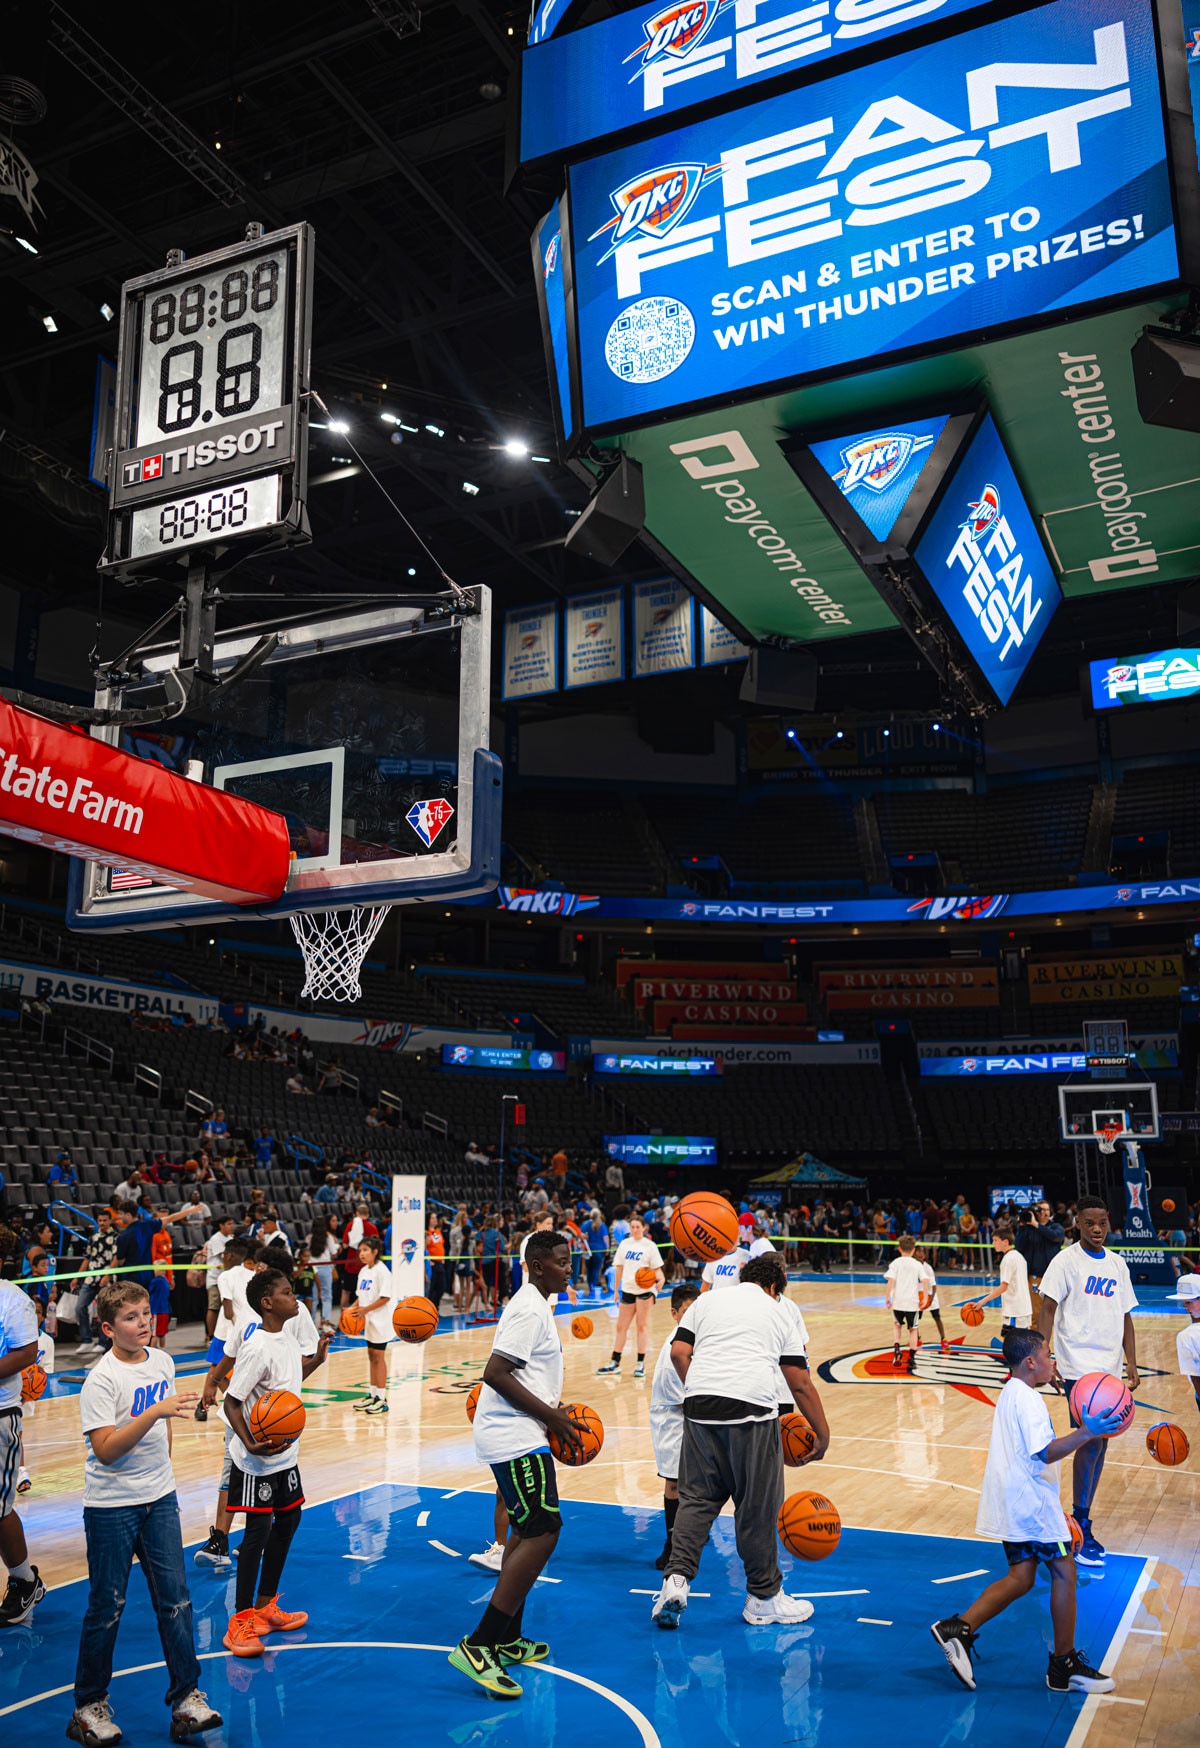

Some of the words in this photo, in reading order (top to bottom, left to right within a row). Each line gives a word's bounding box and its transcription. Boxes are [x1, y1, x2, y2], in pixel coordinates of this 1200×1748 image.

[720, 21, 1130, 207] FAN
[615, 89, 1132, 299] FEST
[616, 173, 685, 238] OKC
[711, 271, 806, 316] SCAN
[817, 262, 841, 287] &
[851, 227, 975, 277] ENTER
[985, 206, 1041, 240] TO
[712, 310, 786, 350] WIN
[794, 262, 975, 329] THUNDER
[987, 214, 1145, 278] PRIZES!
[1058, 351, 1116, 443] center
[166, 421, 284, 474] TISSOT
[843, 441, 899, 489] OKC
[701, 479, 804, 572] paycom
[790, 577, 852, 625] center
[984, 514, 1043, 636] FAN
[946, 526, 1024, 662] FEST
[844, 971, 974, 987] RIVERWIND
[1037, 958, 1176, 980] RIVERWIND
[36, 976, 187, 1016] BASKETBALL
[641, 982, 792, 1000] RIVERWIND
[870, 992, 955, 1006] CASINO
[1060, 982, 1150, 999] CASINO
[684, 1005, 777, 1021] CASINO
[657, 1045, 792, 1062] okcthunder.com
[1100, 1057, 1127, 1065] TISSOT
[692, 1224, 727, 1254] Wilson
[1126, 1228, 1153, 1238] Health
[625, 1250, 643, 1261] OKC
[716, 1264, 736, 1276] OKC
[1084, 1275, 1117, 1298] OKC
[287, 1469, 298, 1492] 19
